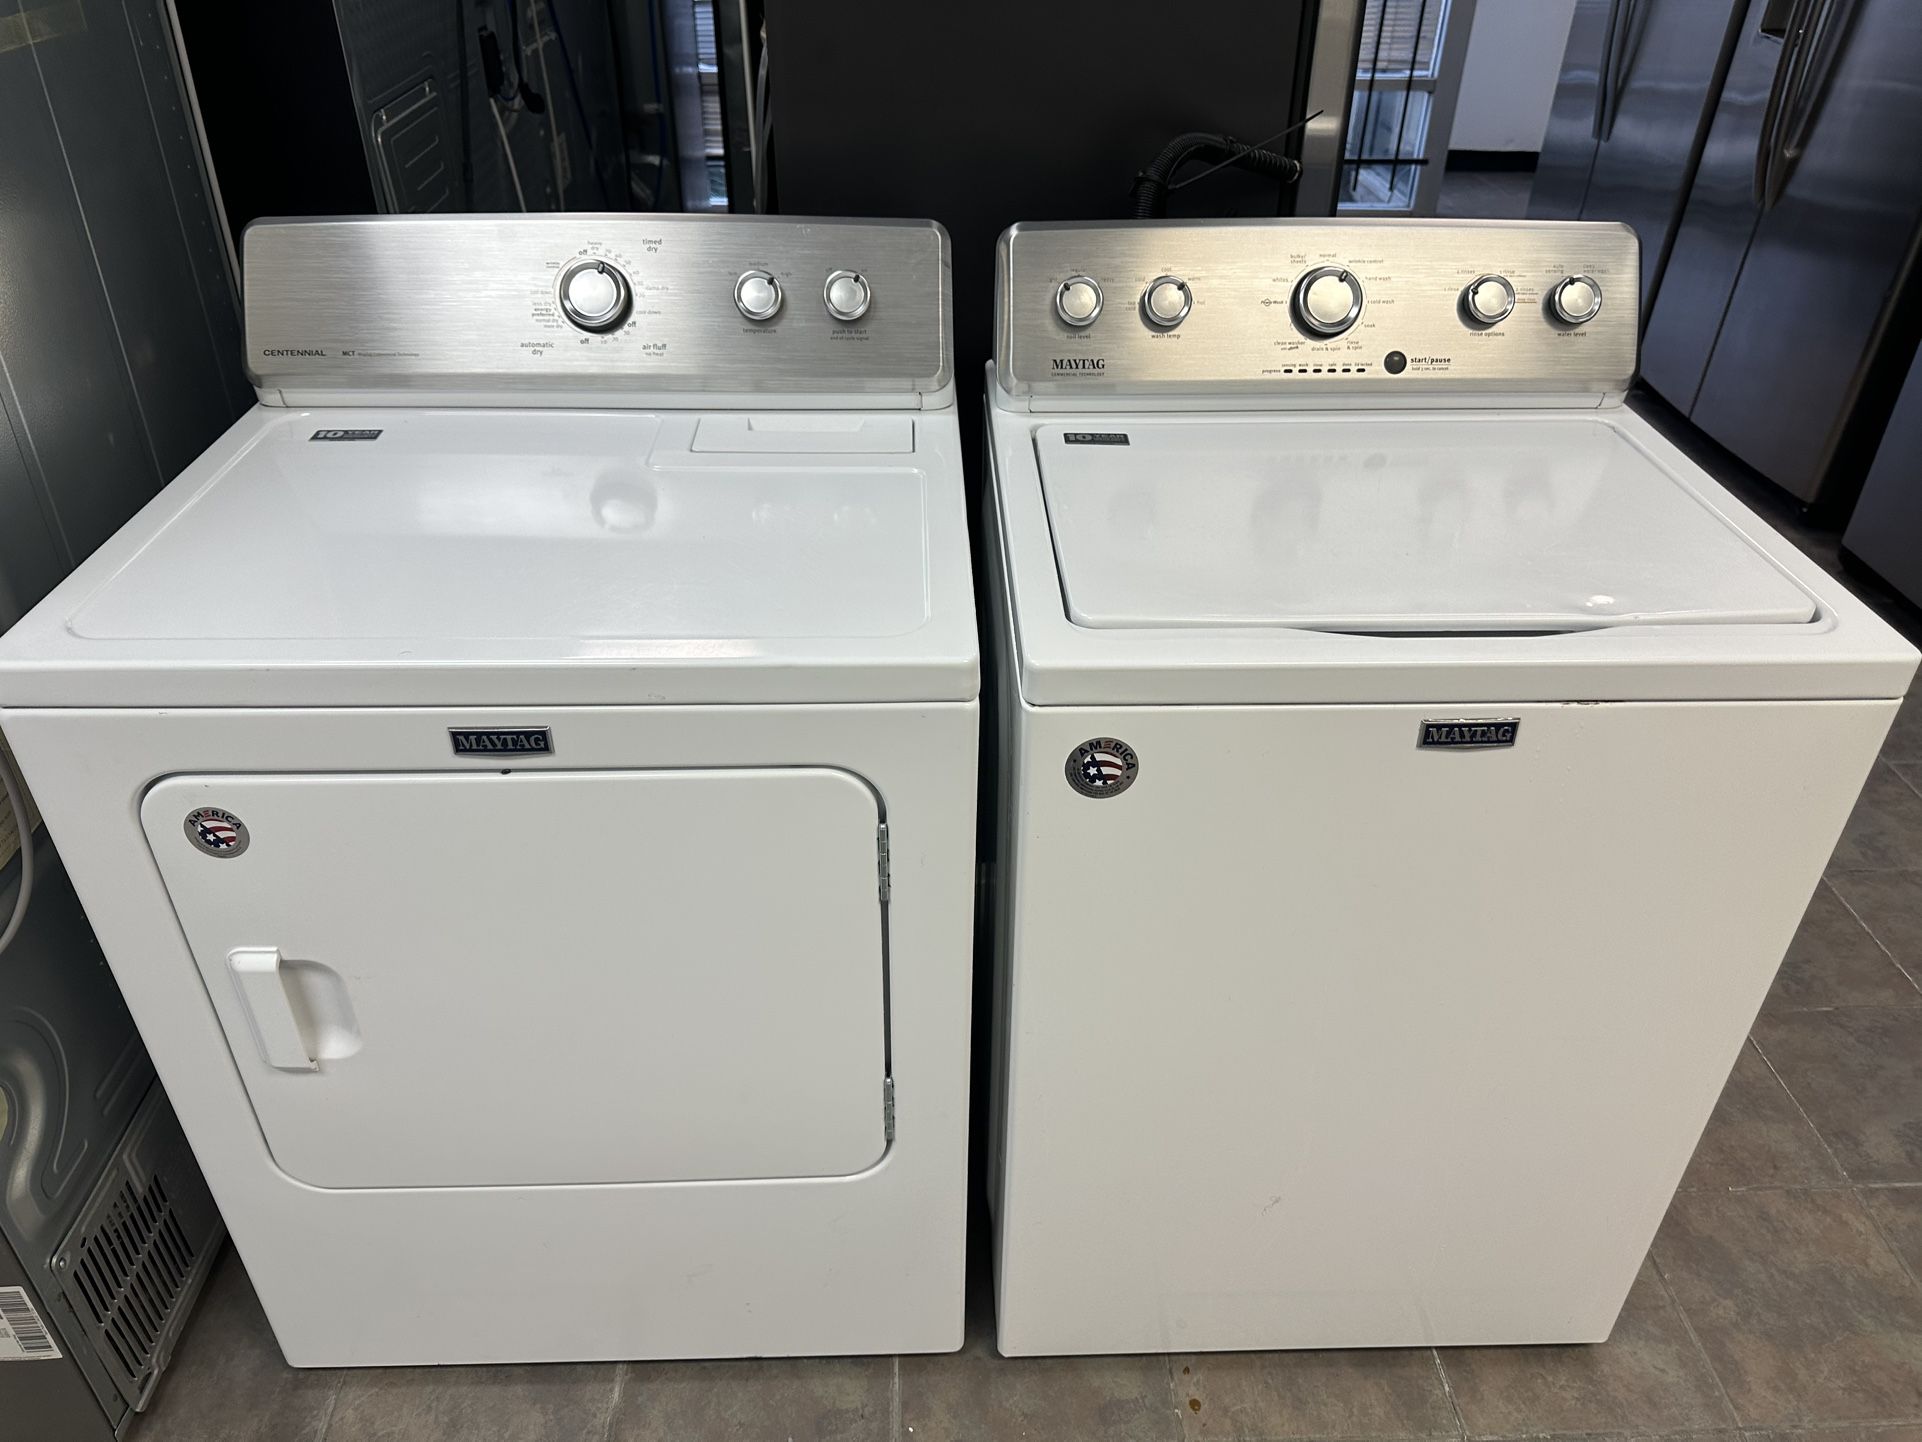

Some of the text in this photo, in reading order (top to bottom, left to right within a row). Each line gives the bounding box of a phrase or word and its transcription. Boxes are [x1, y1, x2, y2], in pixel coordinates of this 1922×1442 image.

[263, 349, 326, 357] CENTENNIAL
[1052, 358, 1105, 370] MAYTAG
[1410, 356, 1451, 364] start/pause
[317, 431, 344, 439] 10
[1066, 433, 1092, 441] 10
[1426, 726, 1512, 742] MAYTAG
[456, 734, 545, 750] MAYTAG
[1078, 740, 1136, 771] AMERICA
[189, 809, 242, 831] AMERICA
